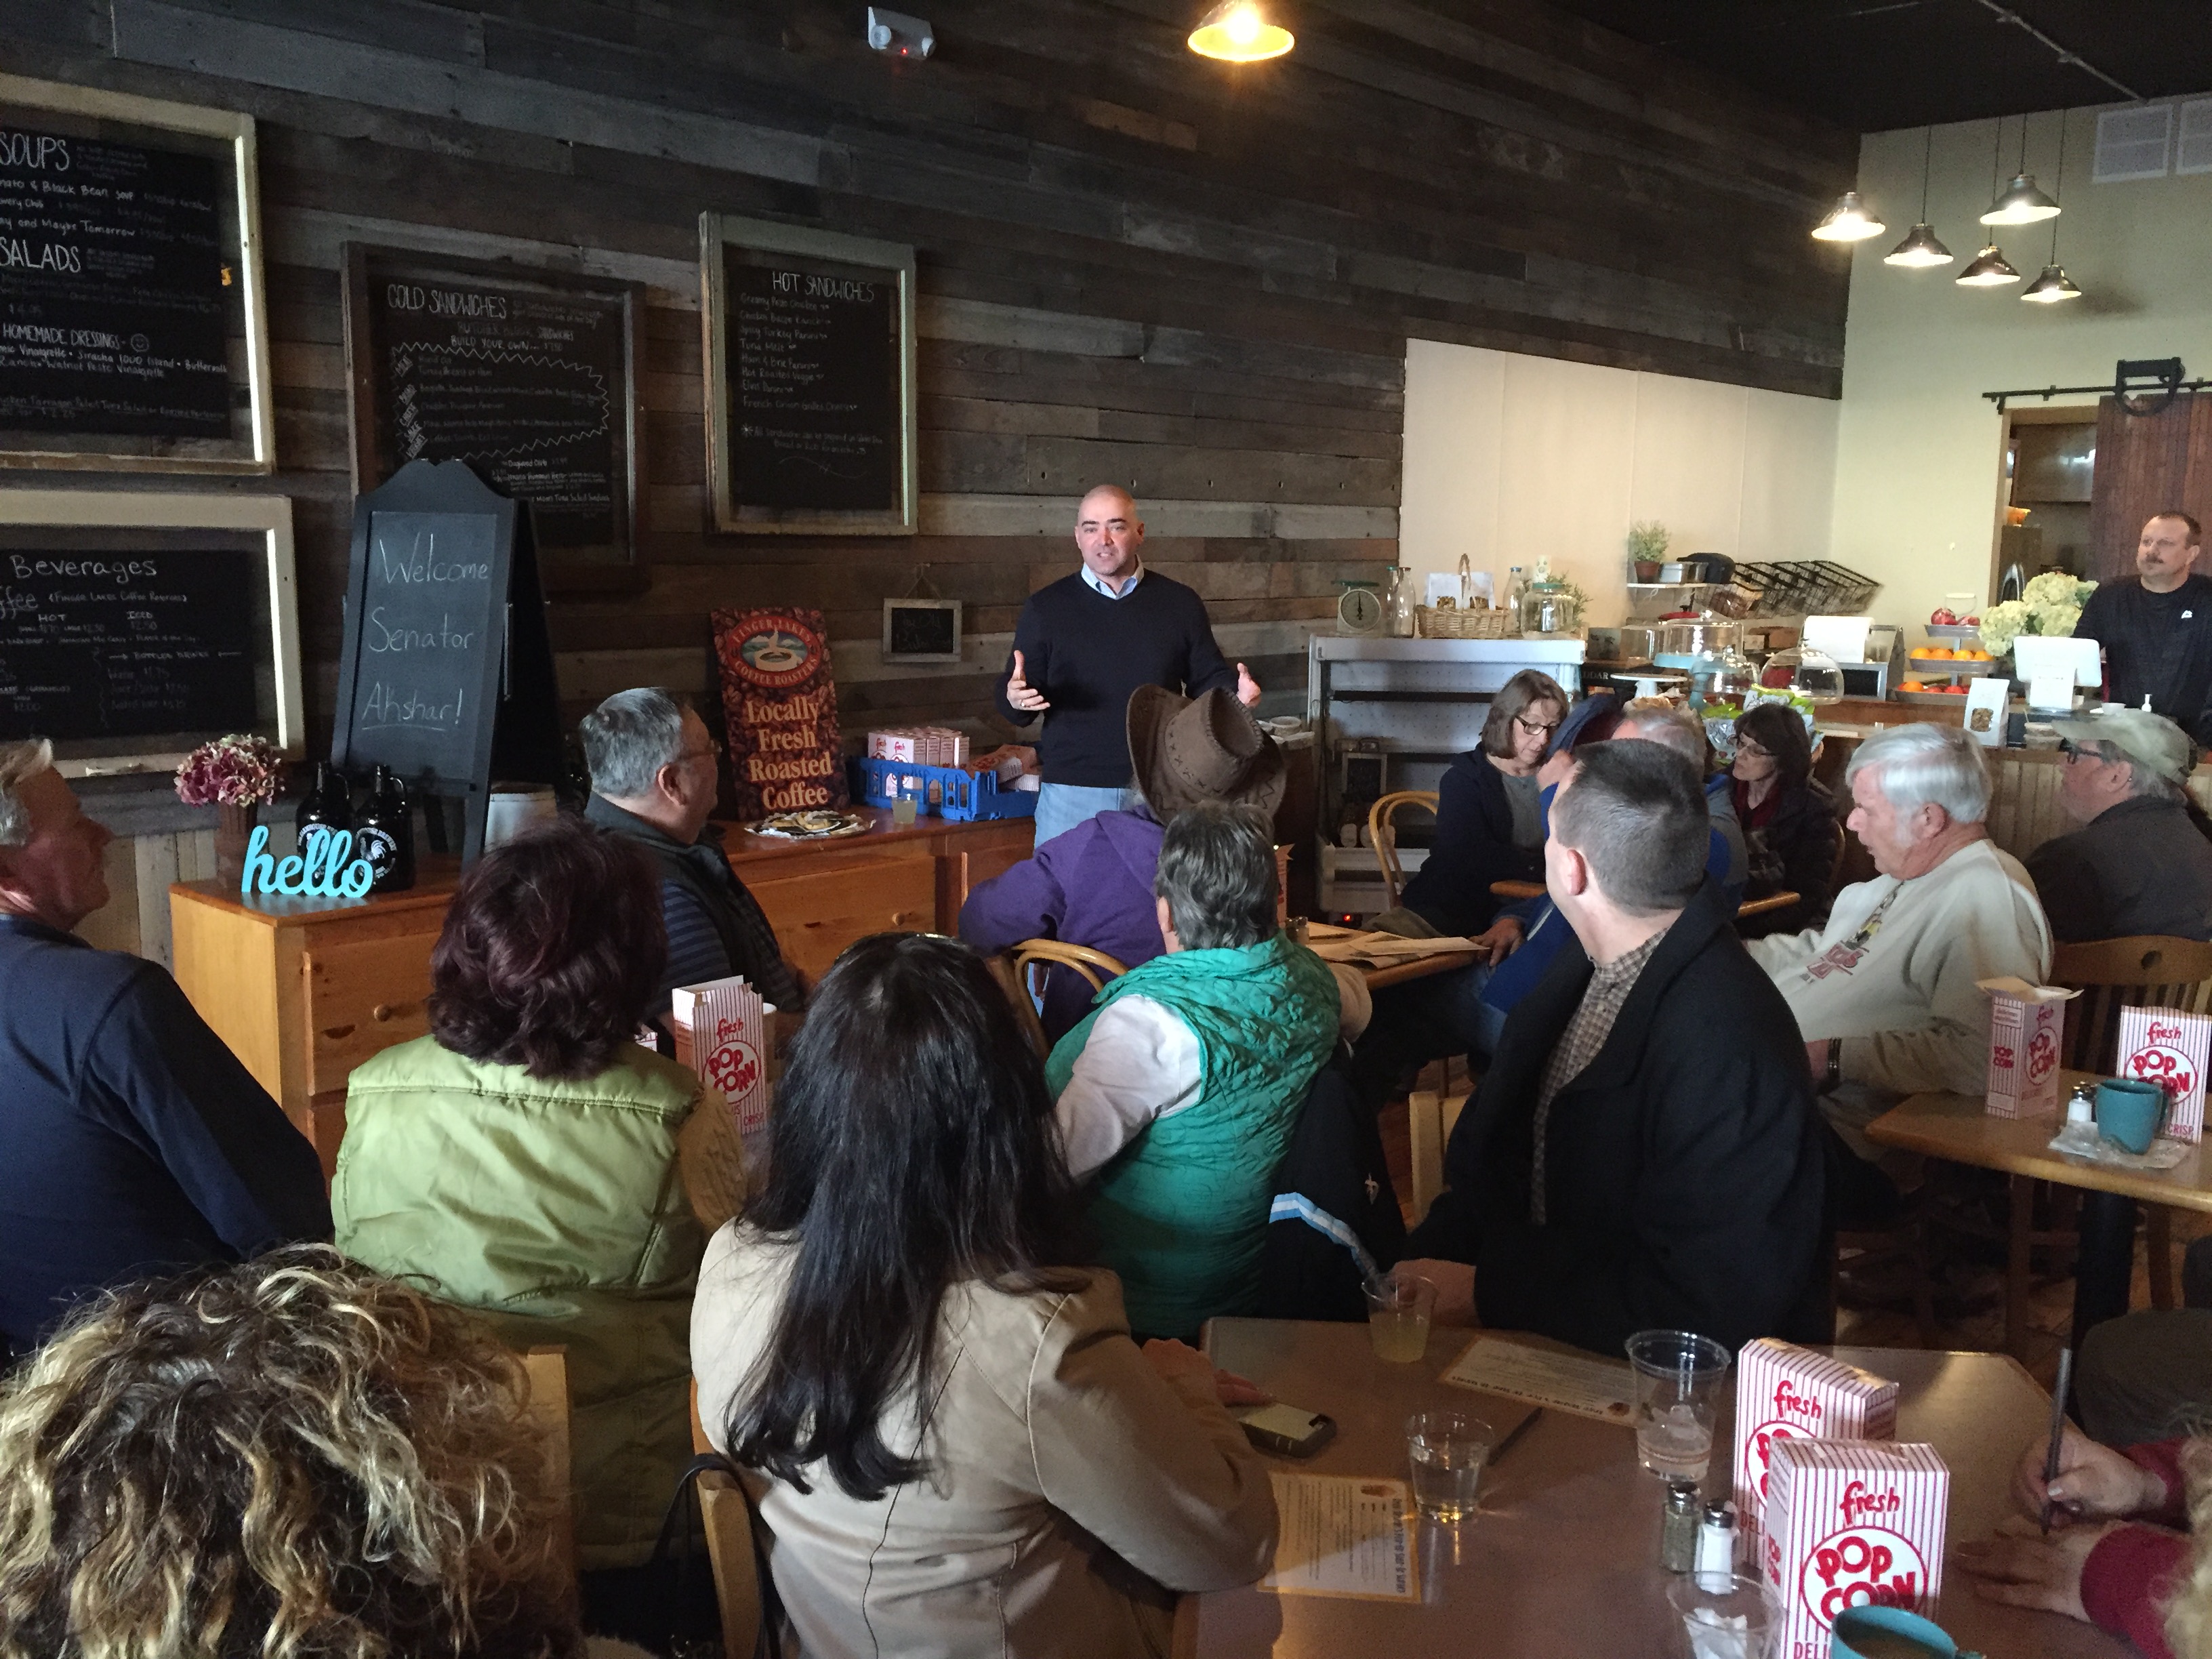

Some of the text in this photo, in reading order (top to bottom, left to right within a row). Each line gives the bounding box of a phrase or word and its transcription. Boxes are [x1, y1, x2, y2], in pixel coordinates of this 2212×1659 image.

[0, 132, 70, 171] SOUPS
[80, 184, 108, 197] Bean
[18, 218, 37, 228] and
[42, 219, 77, 236] Maybe
[79, 220, 136, 237] Tomorrow
[0, 237, 81, 273] SALADS
[772, 270, 875, 303] HOT SANDWICHES
[387, 283, 425, 310] COLD
[428, 289, 507, 319] SANDWICHES
[3, 323, 65, 344] HOMEMADE
[451, 335, 476, 348] BUILD
[481, 338, 504, 350] YOUR
[9, 556, 157, 584] Beverages
[379, 532, 489, 583] Welcome
[38, 613, 67, 622] HOT
[126, 611, 154, 619] ICED
[369, 606, 474, 653] Senator
[732, 619, 811, 644] FINGER LAKES
[735, 658, 817, 685] COFFEE ROASTERS
[745, 699, 819, 725] Locally
[758, 724, 817, 752] Fresh
[749, 752, 834, 783] Roasted
[762, 783, 830, 812] Coffee
[241, 825, 373, 898] hello
[716, 1018, 743, 1042] fresh
[2147, 1021, 2182, 1045] fresh
[709, 1048, 743, 1080] POP
[2133, 1050, 2176, 1076] POP
[2167, 1124, 2194, 1136] CRISP
[1773, 1380, 1822, 1420] fresh
[1840, 1480, 1900, 1525] fresh
[1816, 1536, 1893, 1588] POP
